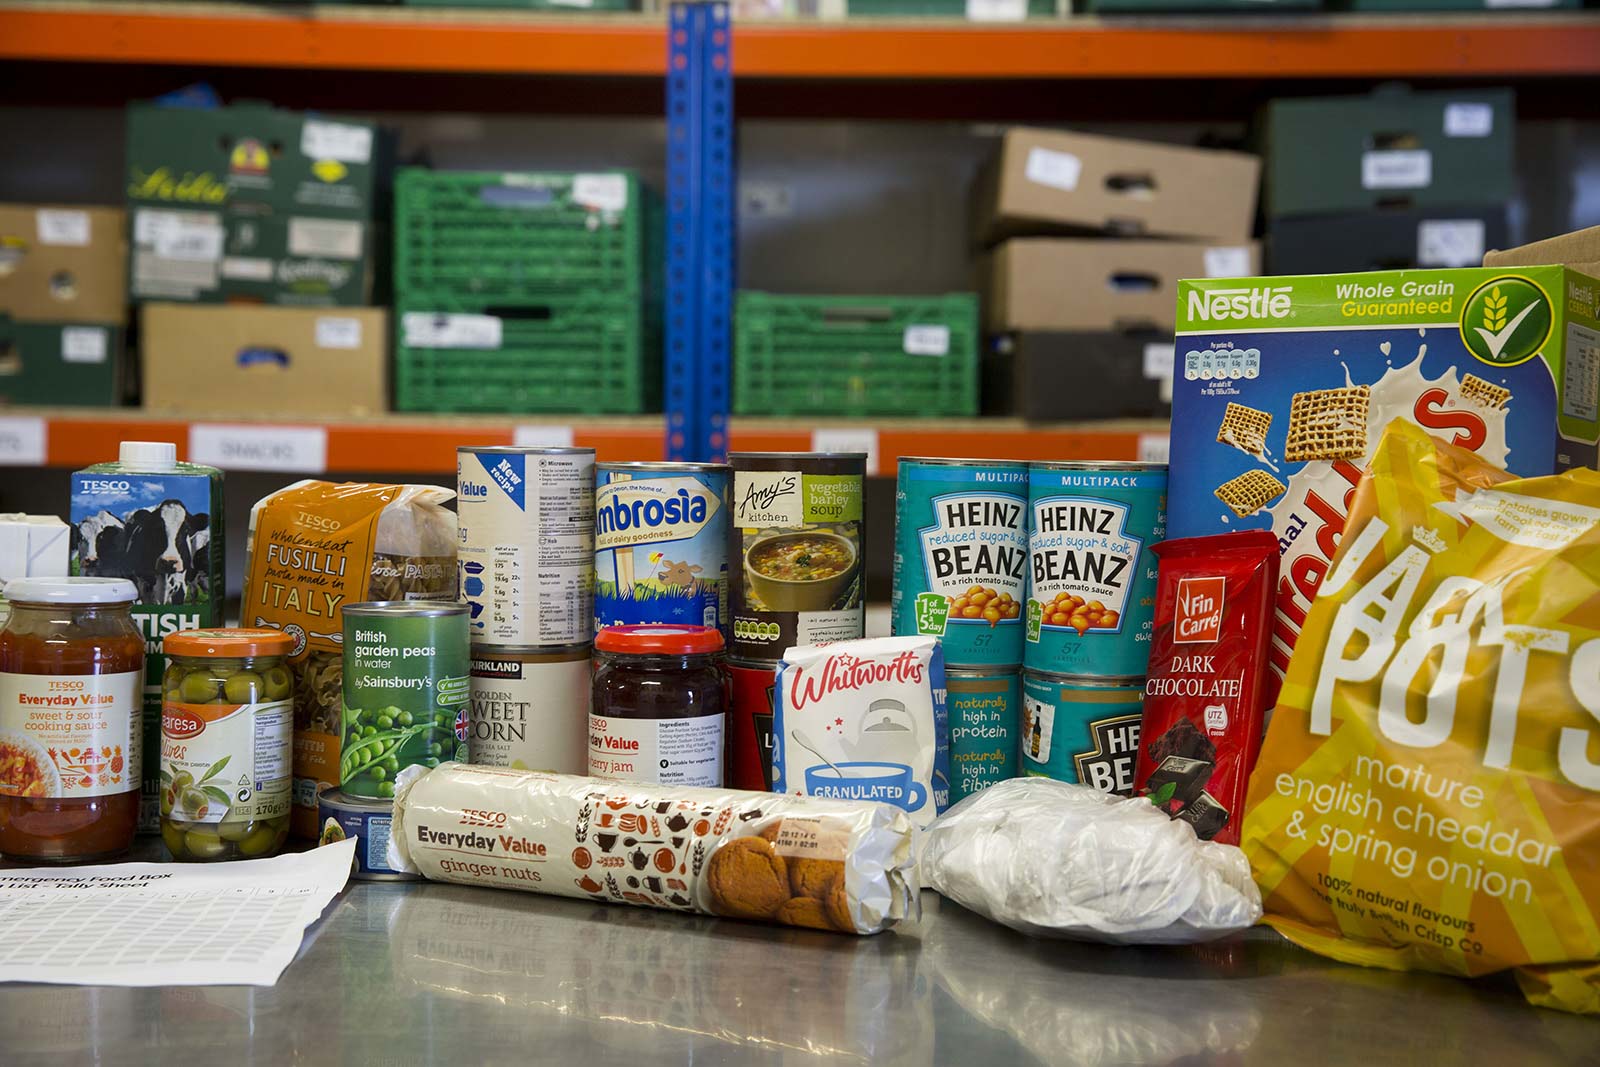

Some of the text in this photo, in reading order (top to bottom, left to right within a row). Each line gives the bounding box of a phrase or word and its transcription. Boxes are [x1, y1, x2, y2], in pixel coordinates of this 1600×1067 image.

[1336, 281, 1455, 299] Whole Grain
[1187, 286, 1292, 321] Nestlé
[1341, 298, 1453, 317] Guaranteed
[490, 467, 515, 494] recipe
[497, 459, 522, 486] New
[80, 480, 130, 491] TESCO
[1061, 476, 1138, 487] MULTIPACK
[739, 476, 796, 519] Amy's
[810, 493, 849, 508] barley
[596, 488, 707, 536] mbrosia
[748, 512, 789, 522] kitchen
[810, 505, 843, 518] soup
[946, 502, 1021, 529] HEINZ
[1498, 499, 1588, 523] Potatoes grown
[298, 511, 341, 530] TESCO
[1041, 506, 1115, 535] HEINZ
[1494, 514, 1521, 535] farm
[613, 535, 632, 543] dairy
[632, 530, 673, 542] goodness
[928, 529, 1015, 546] reduced sugar &
[1032, 534, 1131, 555] reduced sugar & salt
[265, 543, 347, 577] FUSILLI
[931, 545, 1028, 580] BEANZ
[1033, 550, 1128, 588] BEANZ
[264, 566, 345, 591] pasta made in
[942, 579, 950, 587] in
[1002, 579, 1018, 588] sauce
[1048, 583, 1061, 591] rich
[1062, 583, 1090, 592] tomato
[1091, 587, 1114, 597] sauce
[260, 581, 345, 618] ITALY
[921, 598, 946, 616] 1 of your
[1191, 594, 1214, 616] Fin
[919, 615, 929, 630] 5
[929, 621, 943, 632] day
[1180, 609, 1219, 636] Carré
[355, 630, 387, 643] British
[974, 634, 992, 647] 57
[354, 645, 436, 659] garden peas
[1061, 642, 1082, 654] 57
[354, 658, 392, 669] in water
[1170, 656, 1216, 673] DARK
[48, 681, 84, 691] TESCO
[363, 675, 433, 690] Sainsbury's
[790, 650, 924, 711] Whitworths
[1146, 678, 1240, 698] CHOCOLATE
[18, 693, 114, 706] Everyday Value
[474, 690, 512, 700] GOLDEN
[932, 688, 948, 705] TIP
[955, 695, 1007, 711] naturally
[30, 711, 62, 720] sweet
[66, 711, 73, 720] &
[962, 711, 1000, 724] high in
[1207, 711, 1222, 720] UTZ
[24, 721, 108, 733] cooking sauce
[952, 725, 1007, 743] protein
[604, 735, 640, 750] Value
[953, 748, 1006, 766] naturally
[611, 759, 634, 774] jam
[961, 763, 999, 777] high in
[1355, 754, 1485, 809] mature
[814, 785, 903, 800] GRANULATED
[256, 804, 278, 815] 170g
[460, 808, 507, 824] TESCO
[1274, 772, 1563, 868] english cheddar
[417, 825, 496, 852] Everyday
[499, 834, 548, 857] Value
[780, 830, 790, 838] 20
[1285, 810, 1533, 904] & spring onion
[0, 872, 173, 884] mergency Food Box
[440, 857, 497, 877] ginger
[501, 866, 543, 882] nuts
[55, 882, 94, 890] Tally
[98, 881, 151, 889] Sheet
[1317, 872, 1476, 933] 100% natural flavours
[1414, 924, 1455, 948] Crisp
[1458, 937, 1483, 955] Co
